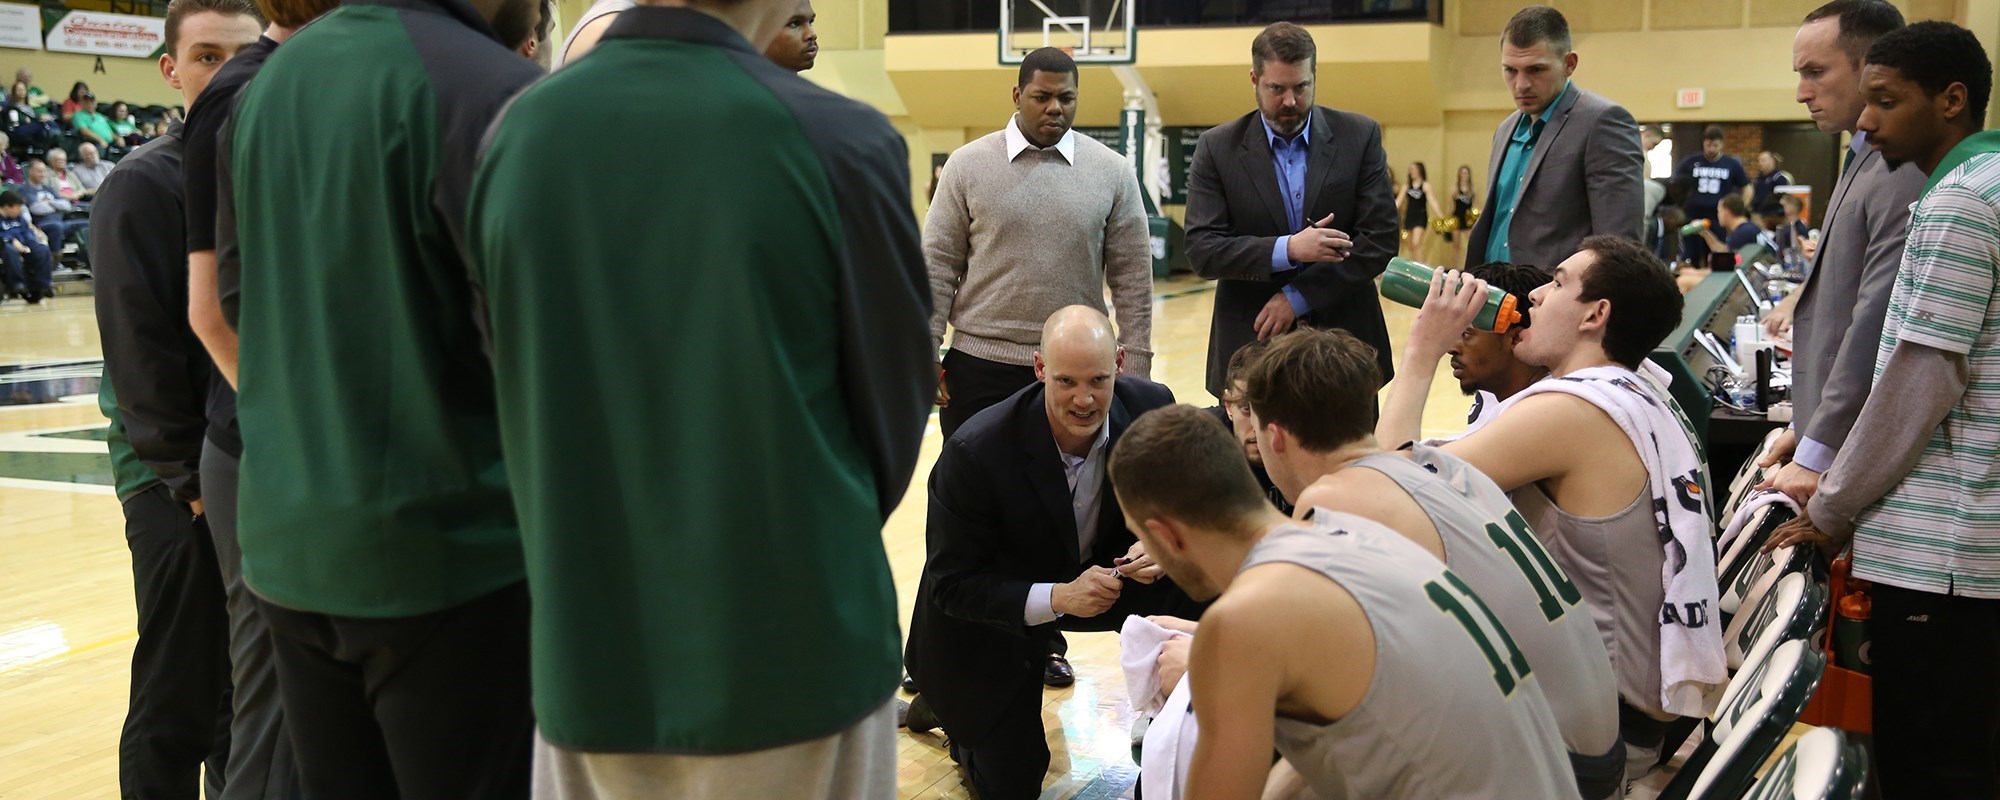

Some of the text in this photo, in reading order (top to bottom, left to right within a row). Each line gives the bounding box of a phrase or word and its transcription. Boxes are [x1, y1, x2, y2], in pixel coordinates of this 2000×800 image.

[93, 56, 106, 74] A
[1485, 508, 1582, 623] 10
[1423, 569, 1532, 697] 11
